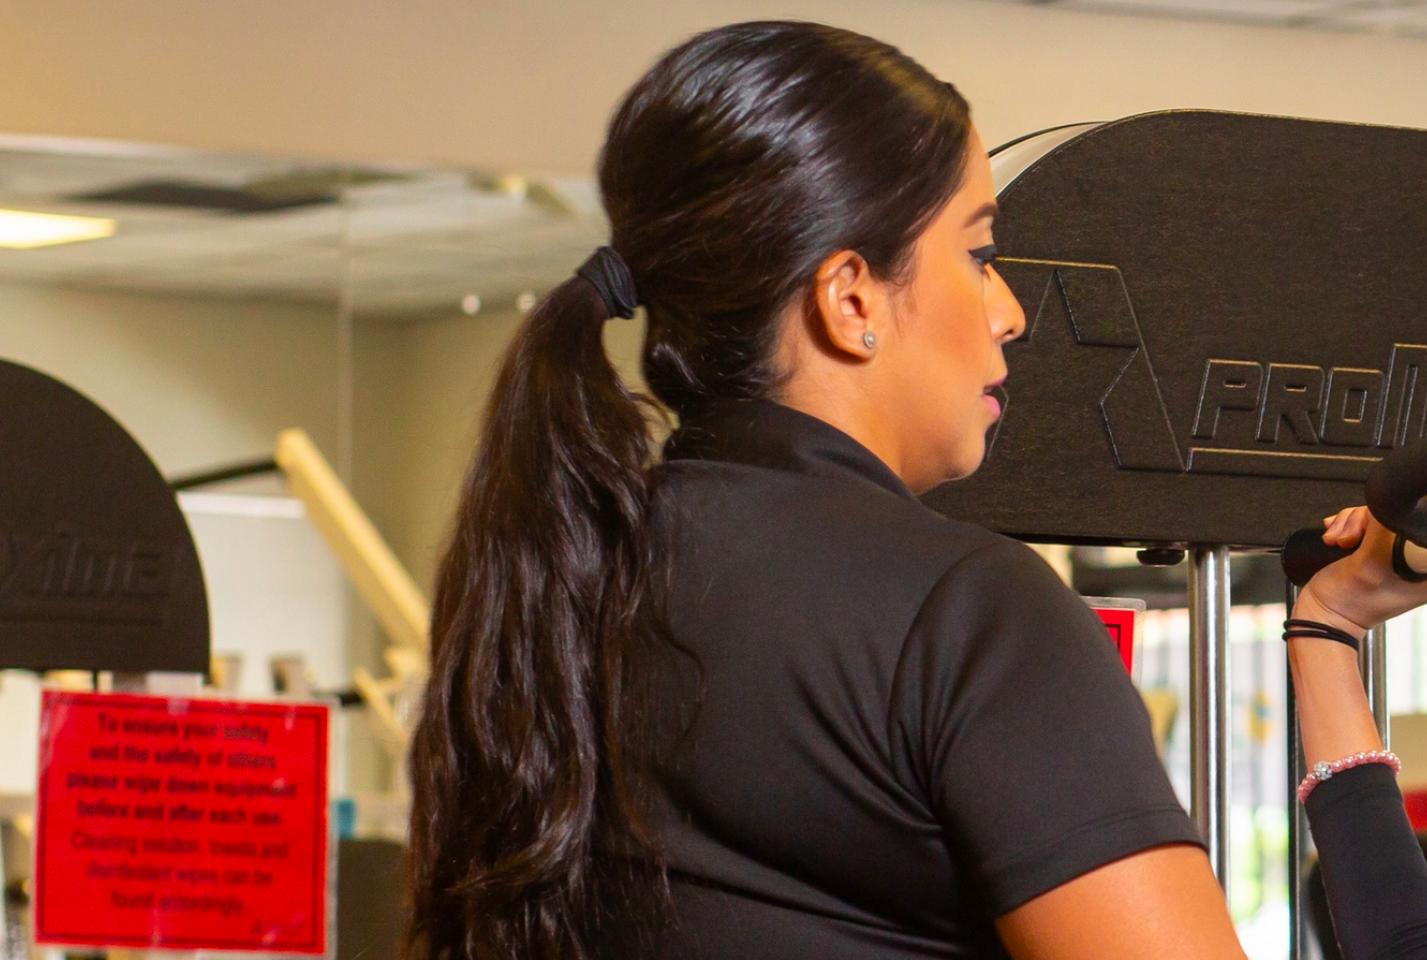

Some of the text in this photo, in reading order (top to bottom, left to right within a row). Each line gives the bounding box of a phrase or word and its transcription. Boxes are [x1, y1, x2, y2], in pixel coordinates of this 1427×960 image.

[98, 713, 269, 747] To ensure your safety
[89, 744, 277, 769] and the safety of others
[66, 772, 297, 800] please wipe down equipment
[77, 799, 129, 819] before
[134, 803, 164, 820] and
[168, 804, 205, 822] after
[209, 806, 247, 824] each
[71, 831, 138, 856] Cleaning
